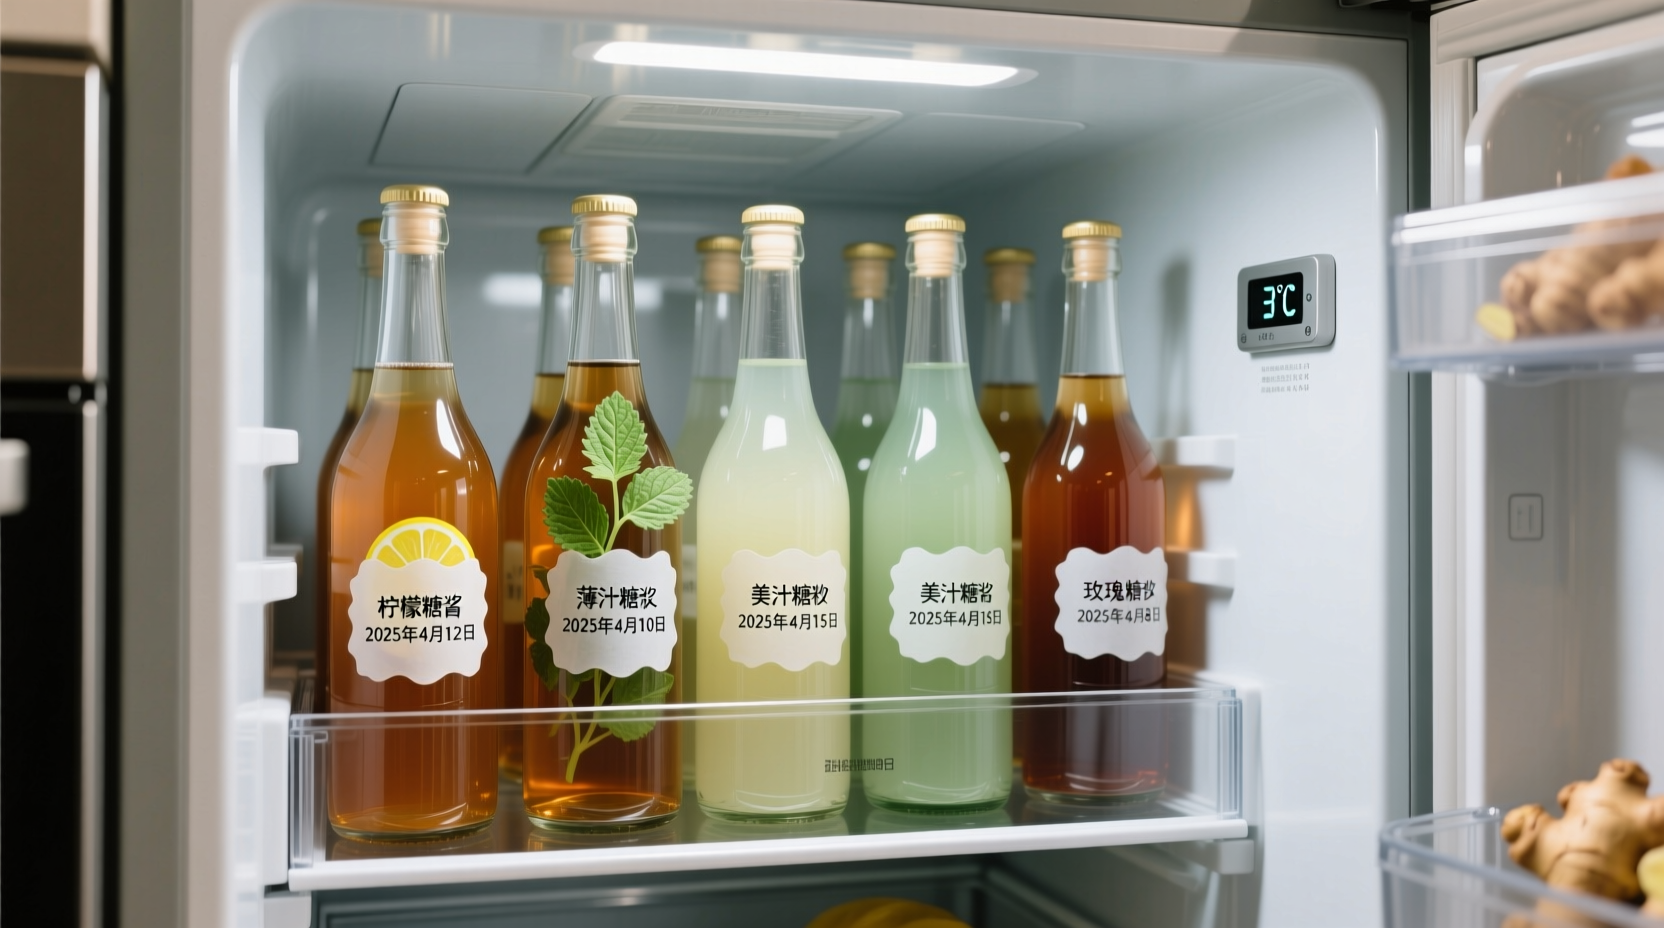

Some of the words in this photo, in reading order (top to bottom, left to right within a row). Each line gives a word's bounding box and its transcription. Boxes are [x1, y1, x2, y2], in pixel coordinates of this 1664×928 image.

[562, 616, 665, 635] 2025年4月10日
[738, 612, 838, 631] 2025年4月15日
[909, 610, 1002, 627] 2025年4月15日
[365, 624, 475, 644] 2025年4月12日
